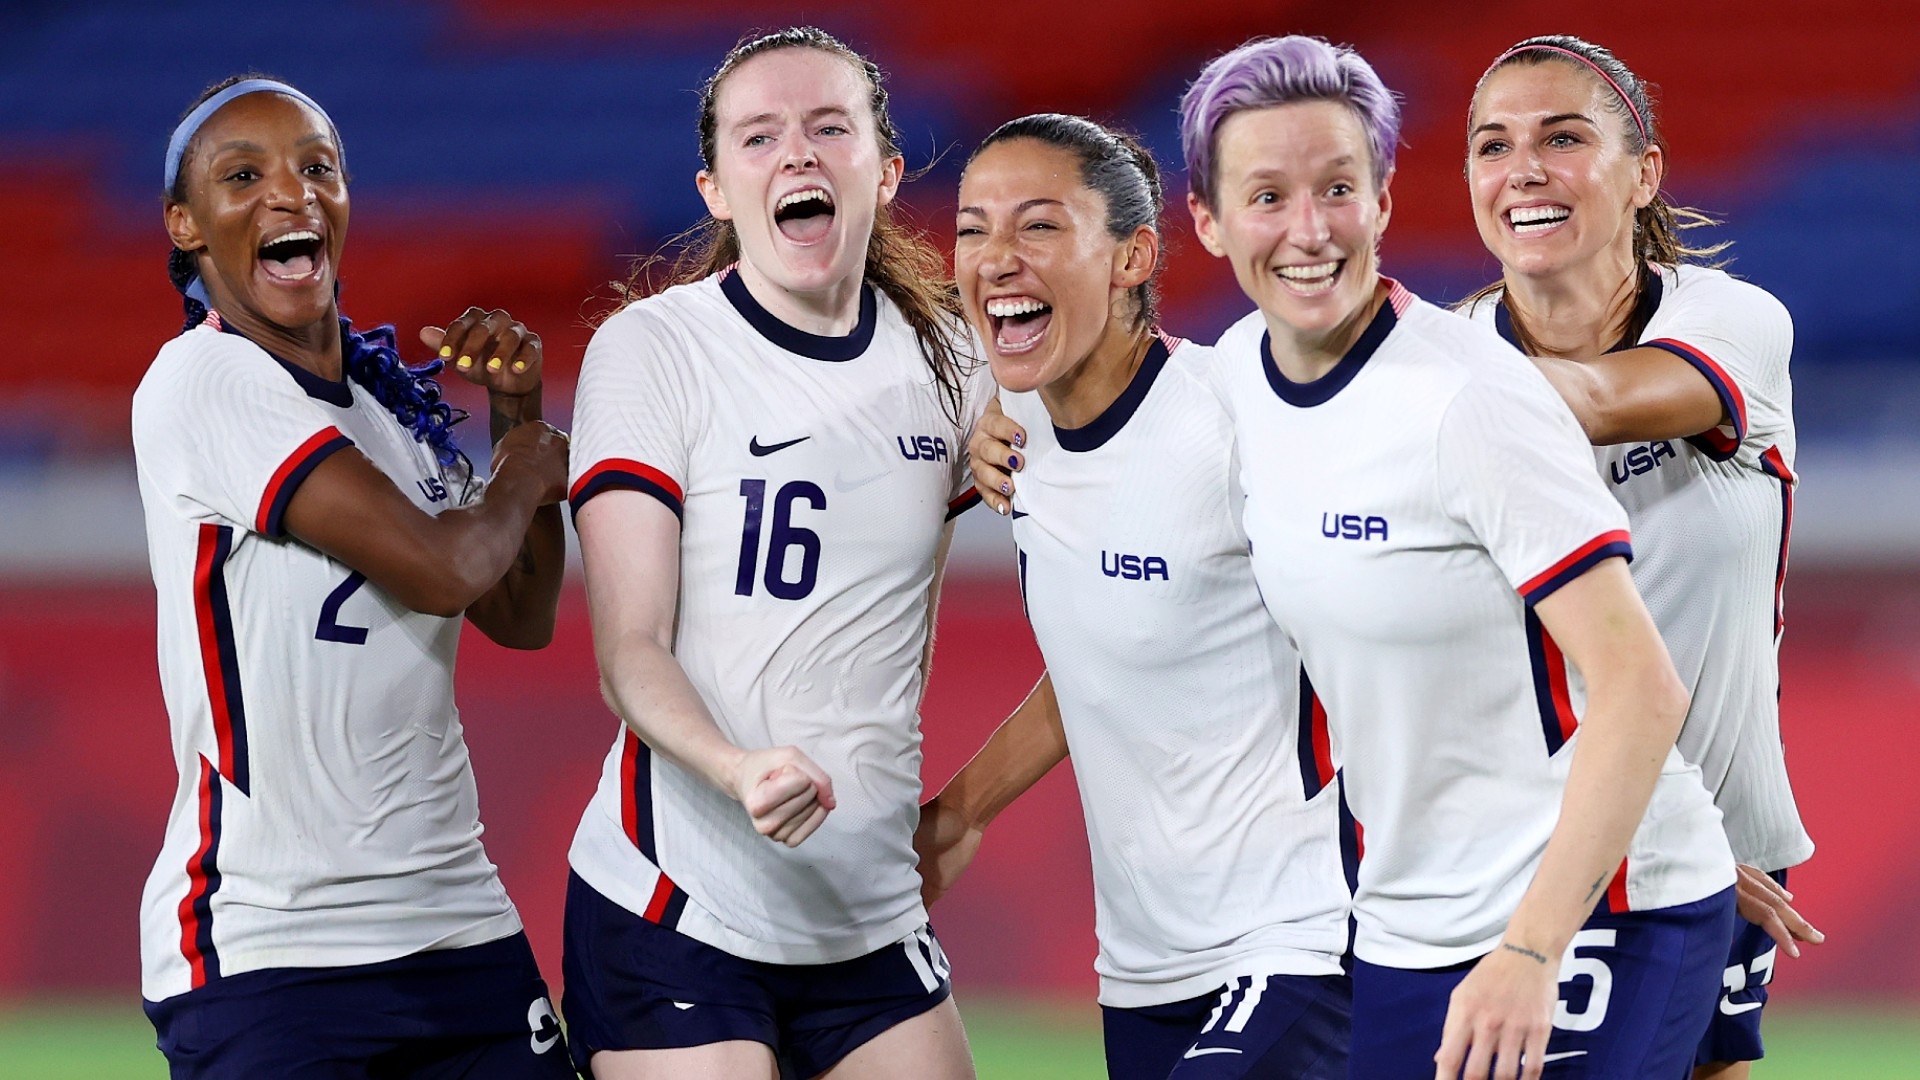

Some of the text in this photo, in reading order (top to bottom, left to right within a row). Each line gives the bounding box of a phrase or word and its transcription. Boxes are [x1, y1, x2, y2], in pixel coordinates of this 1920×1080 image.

[897, 435, 949, 463] USA
[1611, 439, 1677, 485] USA
[416, 472, 448, 503] US
[735, 478, 827, 600] 16
[1321, 512, 1389, 541] USA
[1101, 550, 1169, 581] USA
